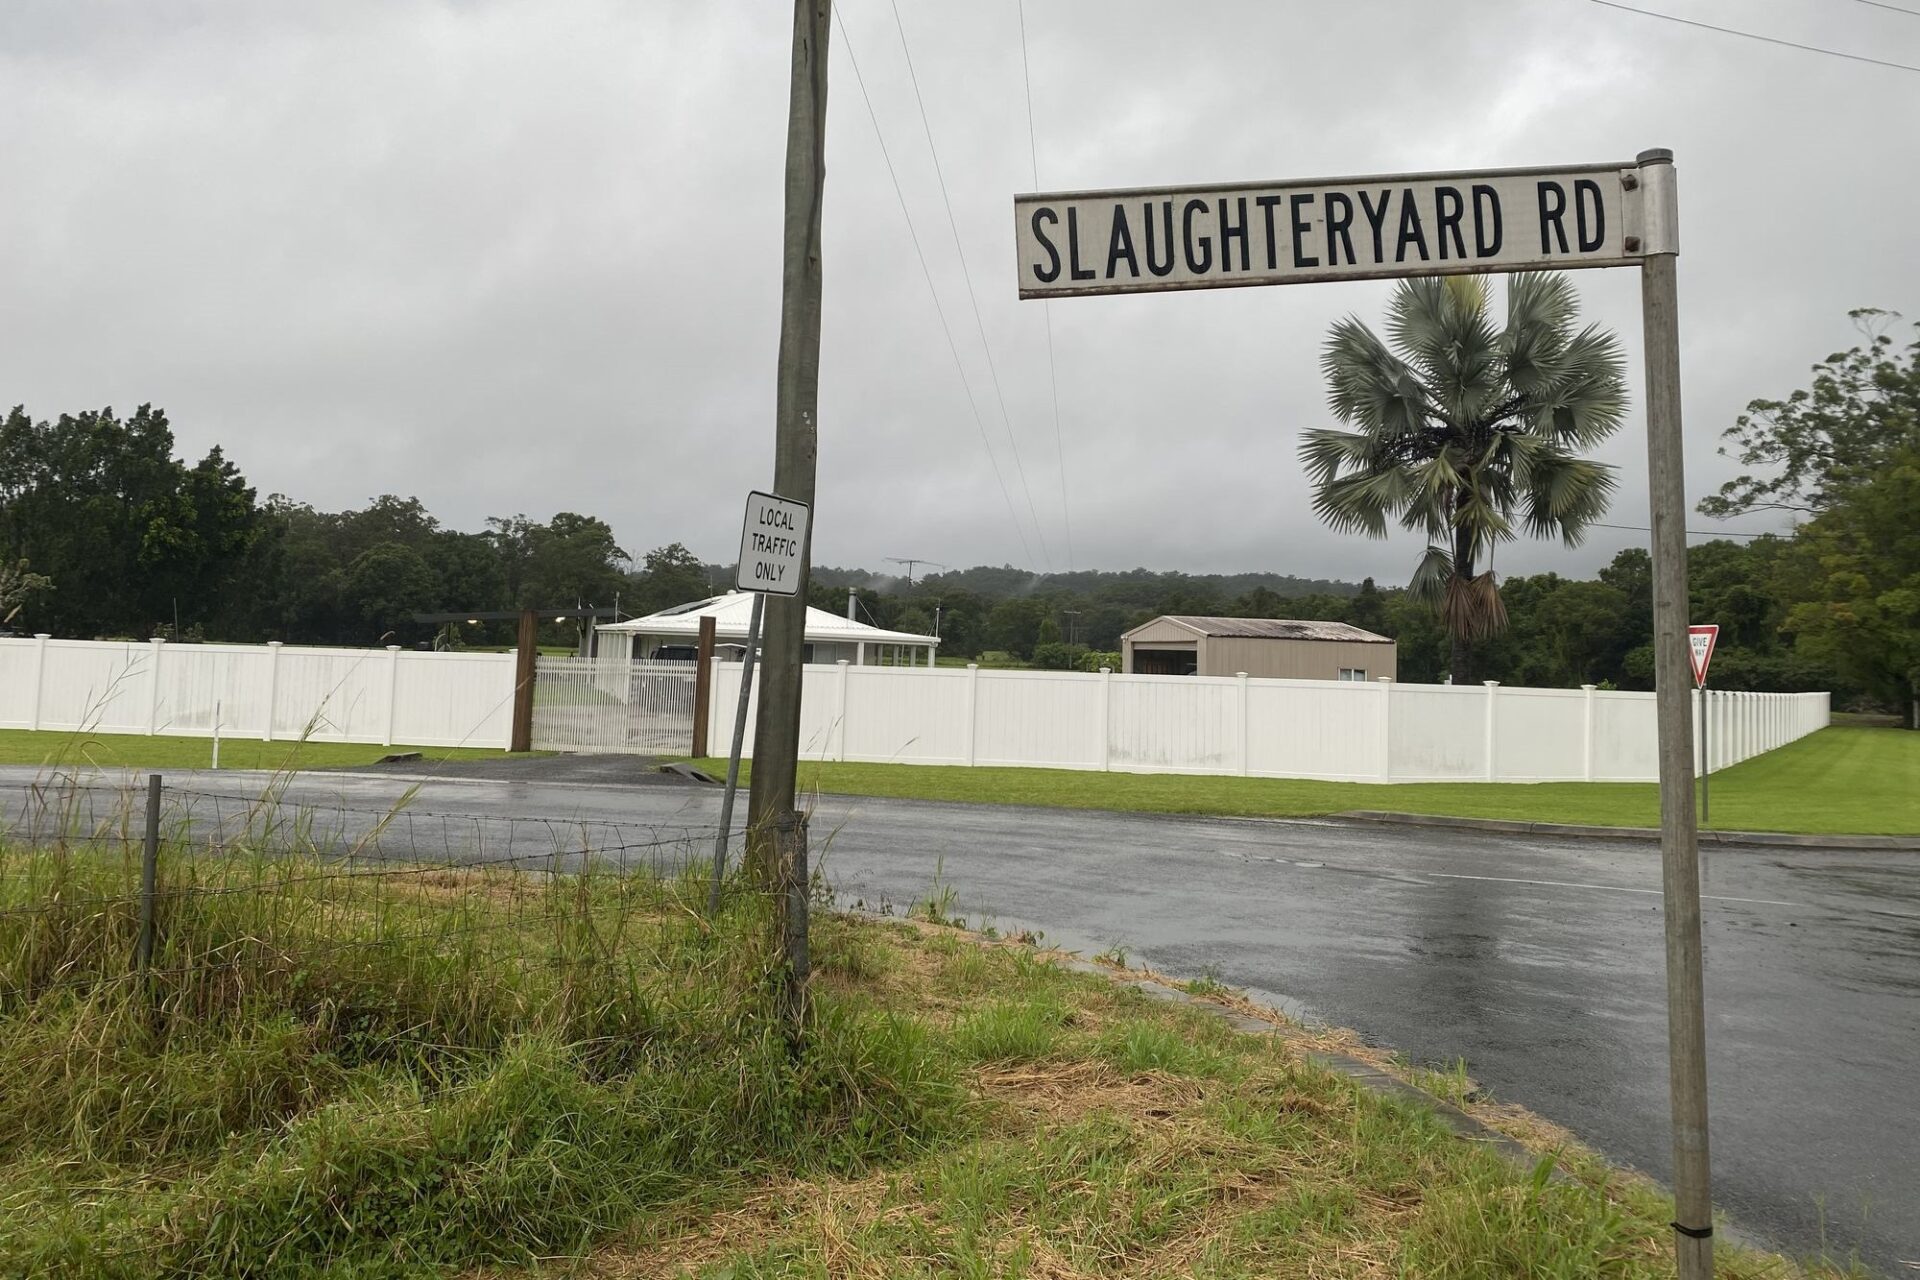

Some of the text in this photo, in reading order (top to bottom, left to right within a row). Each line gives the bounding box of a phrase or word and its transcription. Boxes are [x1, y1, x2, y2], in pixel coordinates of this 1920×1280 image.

[1031, 178, 1606, 283] SLAUGHTERYARD RD
[759, 506, 794, 531] LOCAL
[752, 532, 797, 557] TRAFFIC
[755, 561, 785, 582] ONLY
[1692, 637, 1708, 647] GIVE
